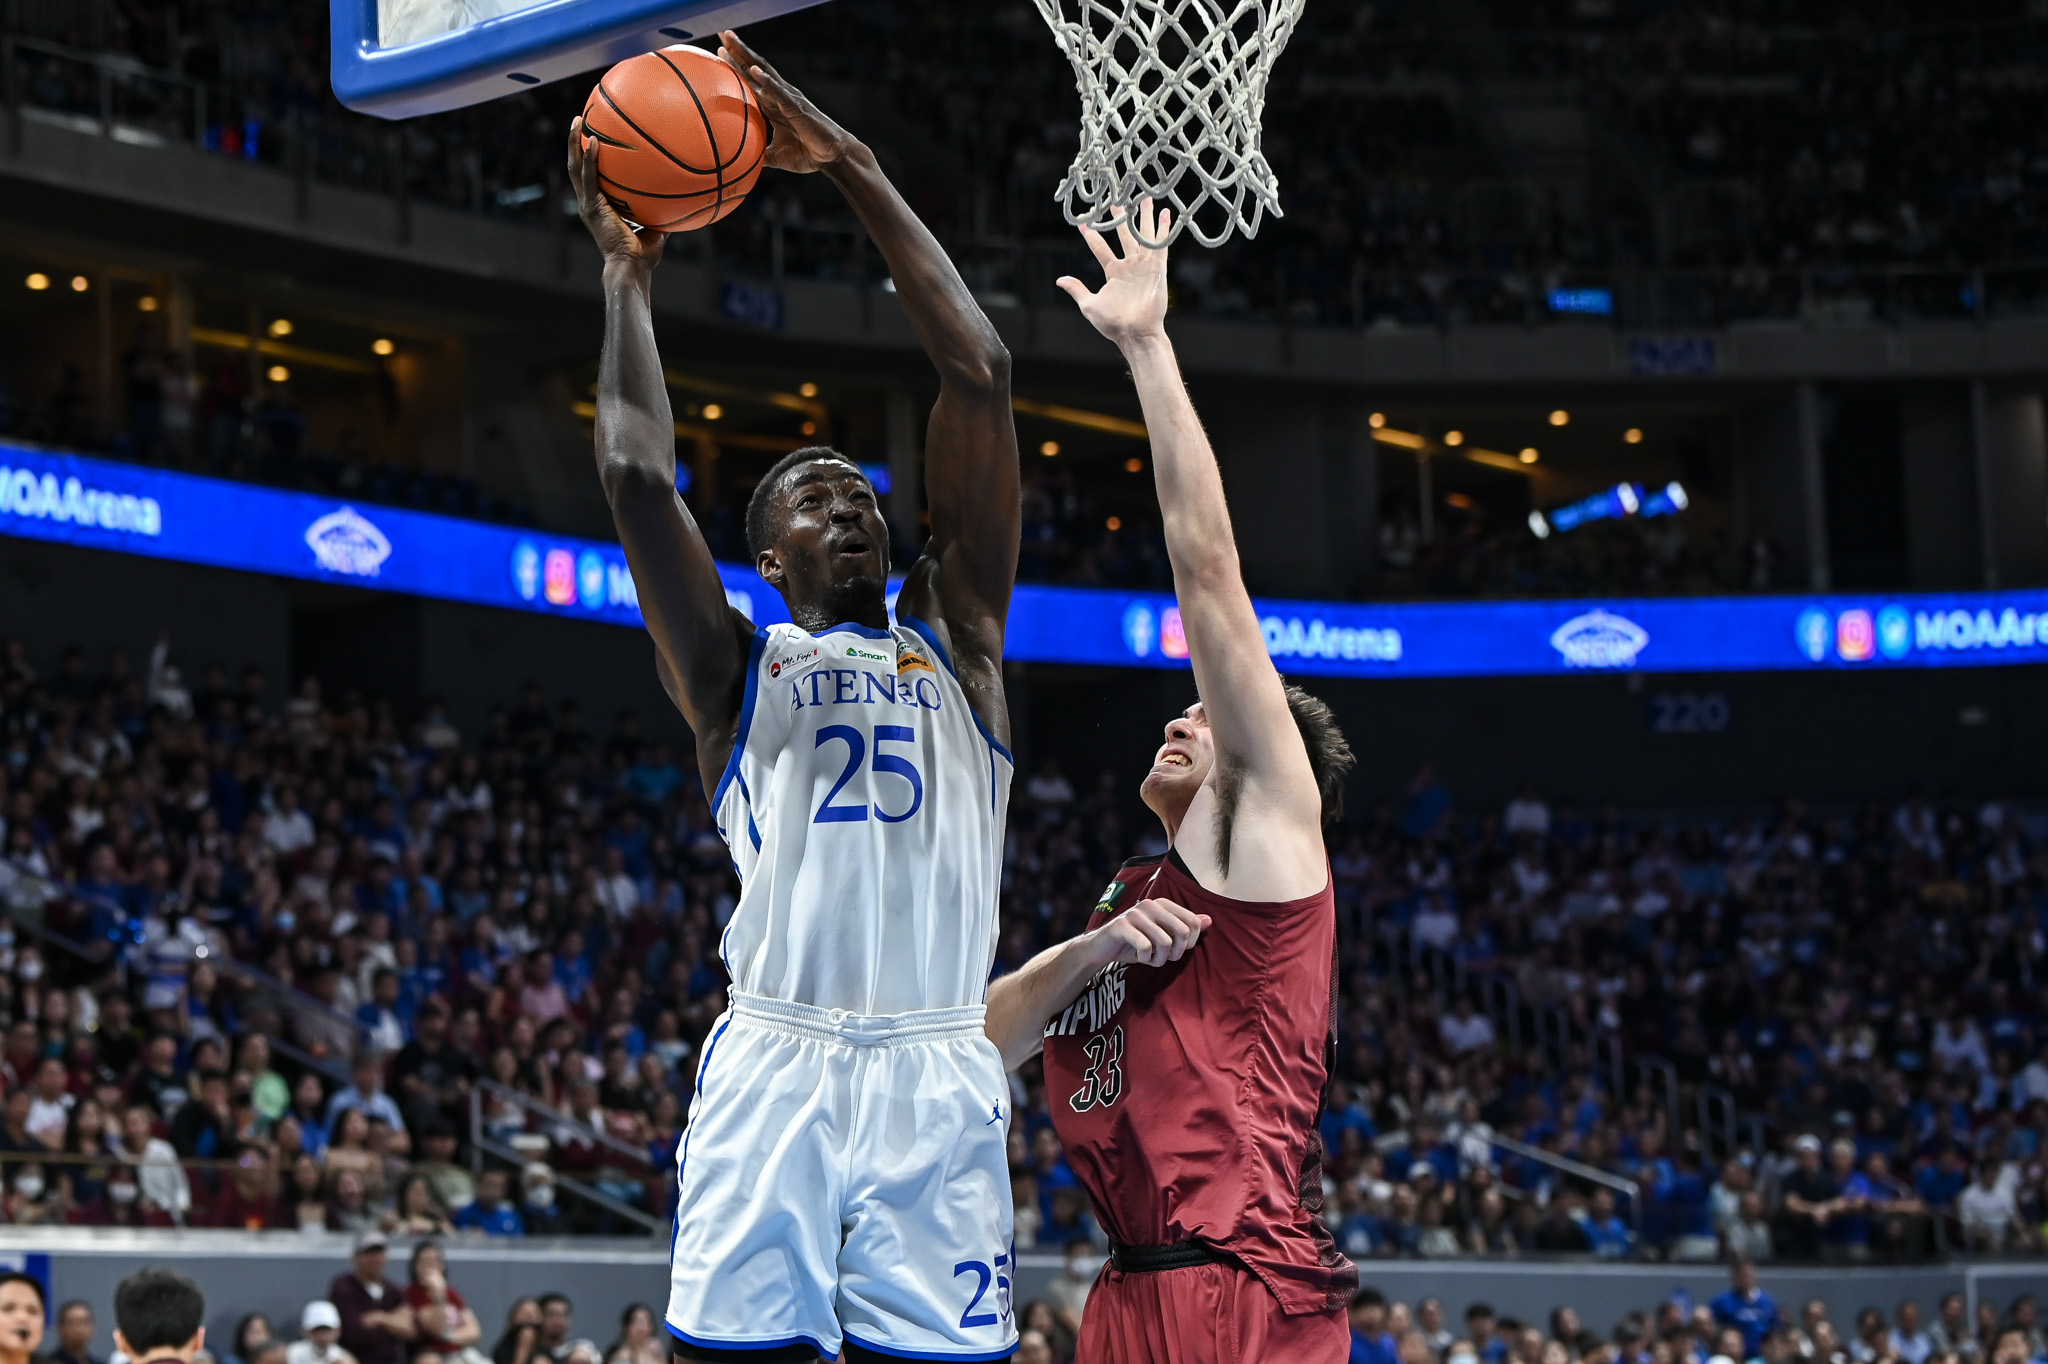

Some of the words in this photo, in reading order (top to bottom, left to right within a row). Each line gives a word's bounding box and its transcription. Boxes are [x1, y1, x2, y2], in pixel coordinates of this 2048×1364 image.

[858, 650, 888, 662] Smart
[1258, 615, 1402, 661] OAArena
[1652, 694, 1728, 731] 220
[813, 724, 923, 824] 25
[1069, 1025, 1123, 1112] 33
